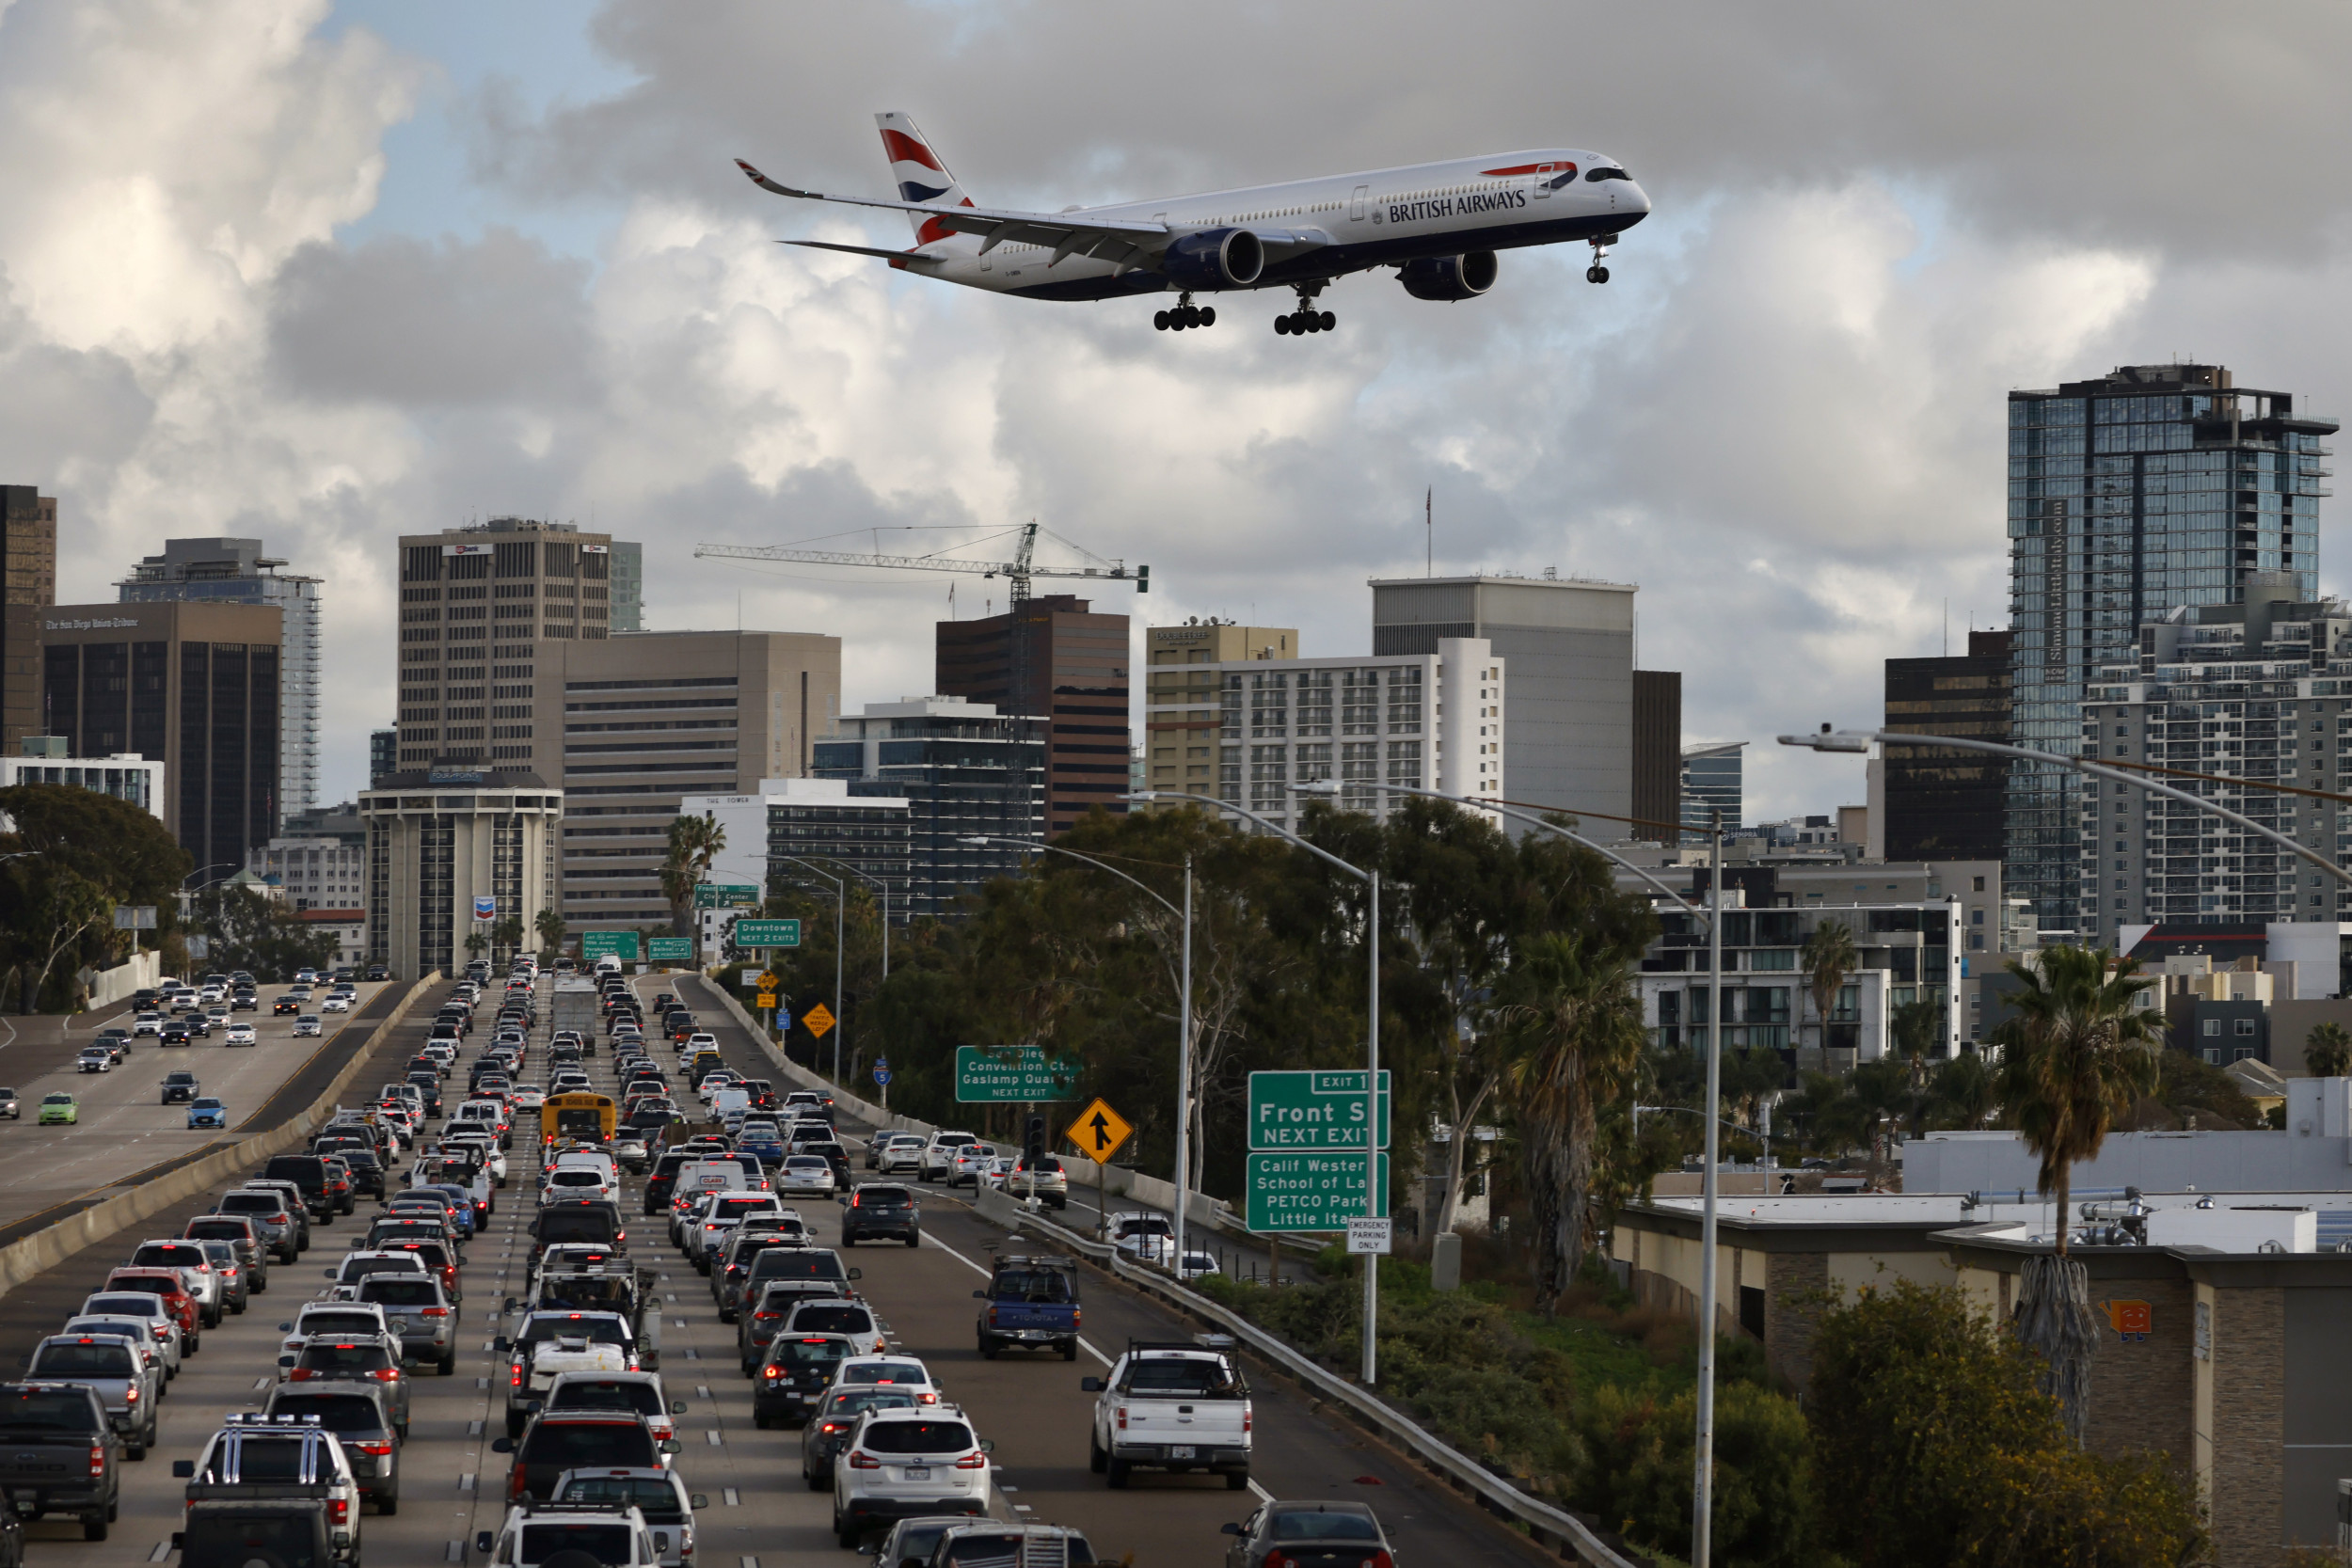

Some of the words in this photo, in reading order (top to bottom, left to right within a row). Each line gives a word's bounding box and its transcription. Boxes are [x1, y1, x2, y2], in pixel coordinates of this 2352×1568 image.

[1390, 198, 1453, 224] BRITISH
[1456, 189, 1526, 215] AIRWAYS
[742, 924, 794, 932] Downtown
[1017, 1049, 1046, 1061] Dieg
[968, 1061, 1043, 1071] Convention
[879, 1073, 886, 1083] 5
[962, 1074, 1019, 1086] Gaslamp
[1322, 1077, 1353, 1087] EXIT
[992, 1088, 1019, 1097] NEXT
[1024, 1088, 1046, 1097] EXIT
[1260, 1102, 1334, 1123] Front
[1349, 1101, 1366, 1122] S
[1263, 1128, 1319, 1144] NEXT
[1260, 1159, 1299, 1172] Calif
[1307, 1159, 1365, 1172] Wester
[1257, 1177, 1312, 1190] School
[1321, 1176, 1338, 1189] of
[1345, 1176, 1369, 1189] La
[1266, 1195, 1322, 1208] PETCO
[1329, 1195, 1368, 1208] Park
[1269, 1212, 1317, 1226] Little
[1325, 1212, 1364, 1225] Ita
[1349, 1221, 1390, 1230] EMERGENCY
[1352, 1231, 1387, 1240] PARKING
[1358, 1241, 1380, 1250] ONLY
